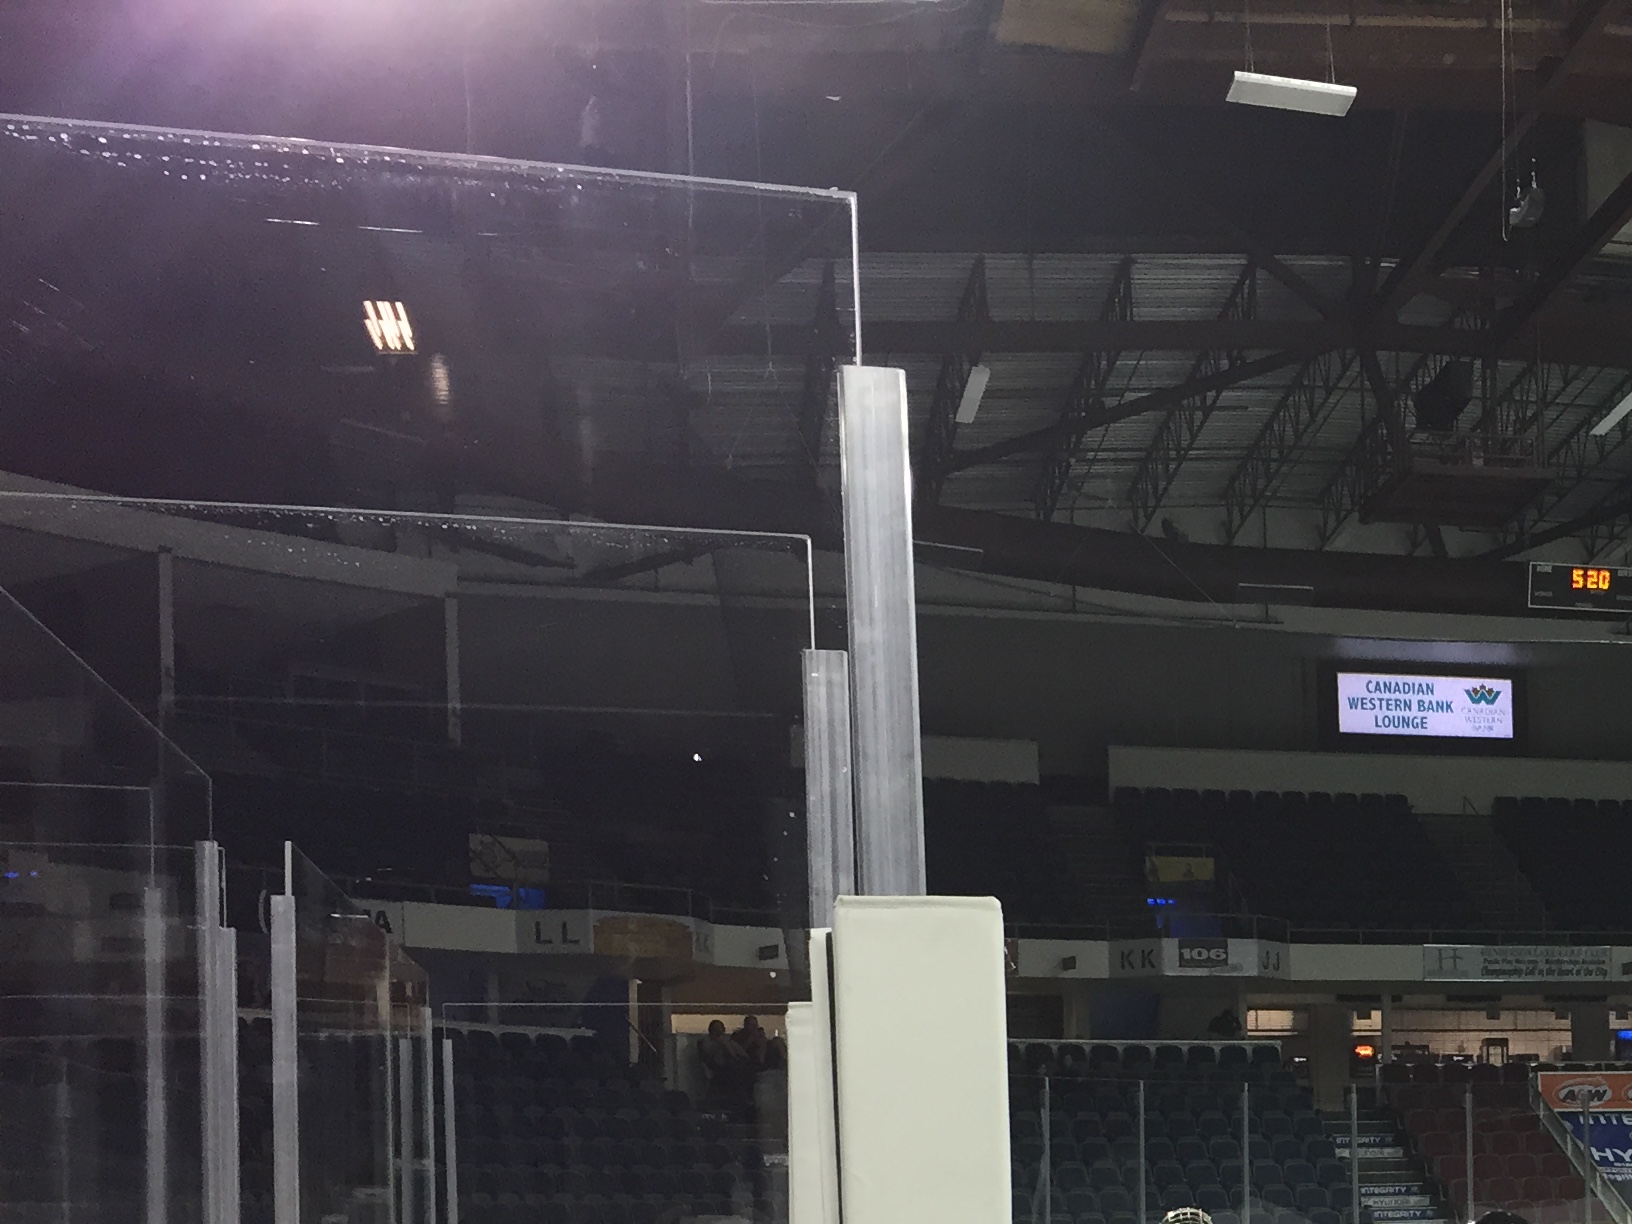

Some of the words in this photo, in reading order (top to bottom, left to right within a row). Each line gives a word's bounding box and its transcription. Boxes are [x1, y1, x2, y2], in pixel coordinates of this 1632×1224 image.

[1366, 680, 1435, 696] CANADIAN
[1347, 696, 1413, 712] WESTERN
[1417, 700, 1454, 714] BANK
[1374, 715, 1428, 730] LOUNGE
[1181, 947, 1227, 961] 106
[1562, 1088, 1608, 1102] A&W
[1373, 1210, 1423, 1219] INTEGRITY
